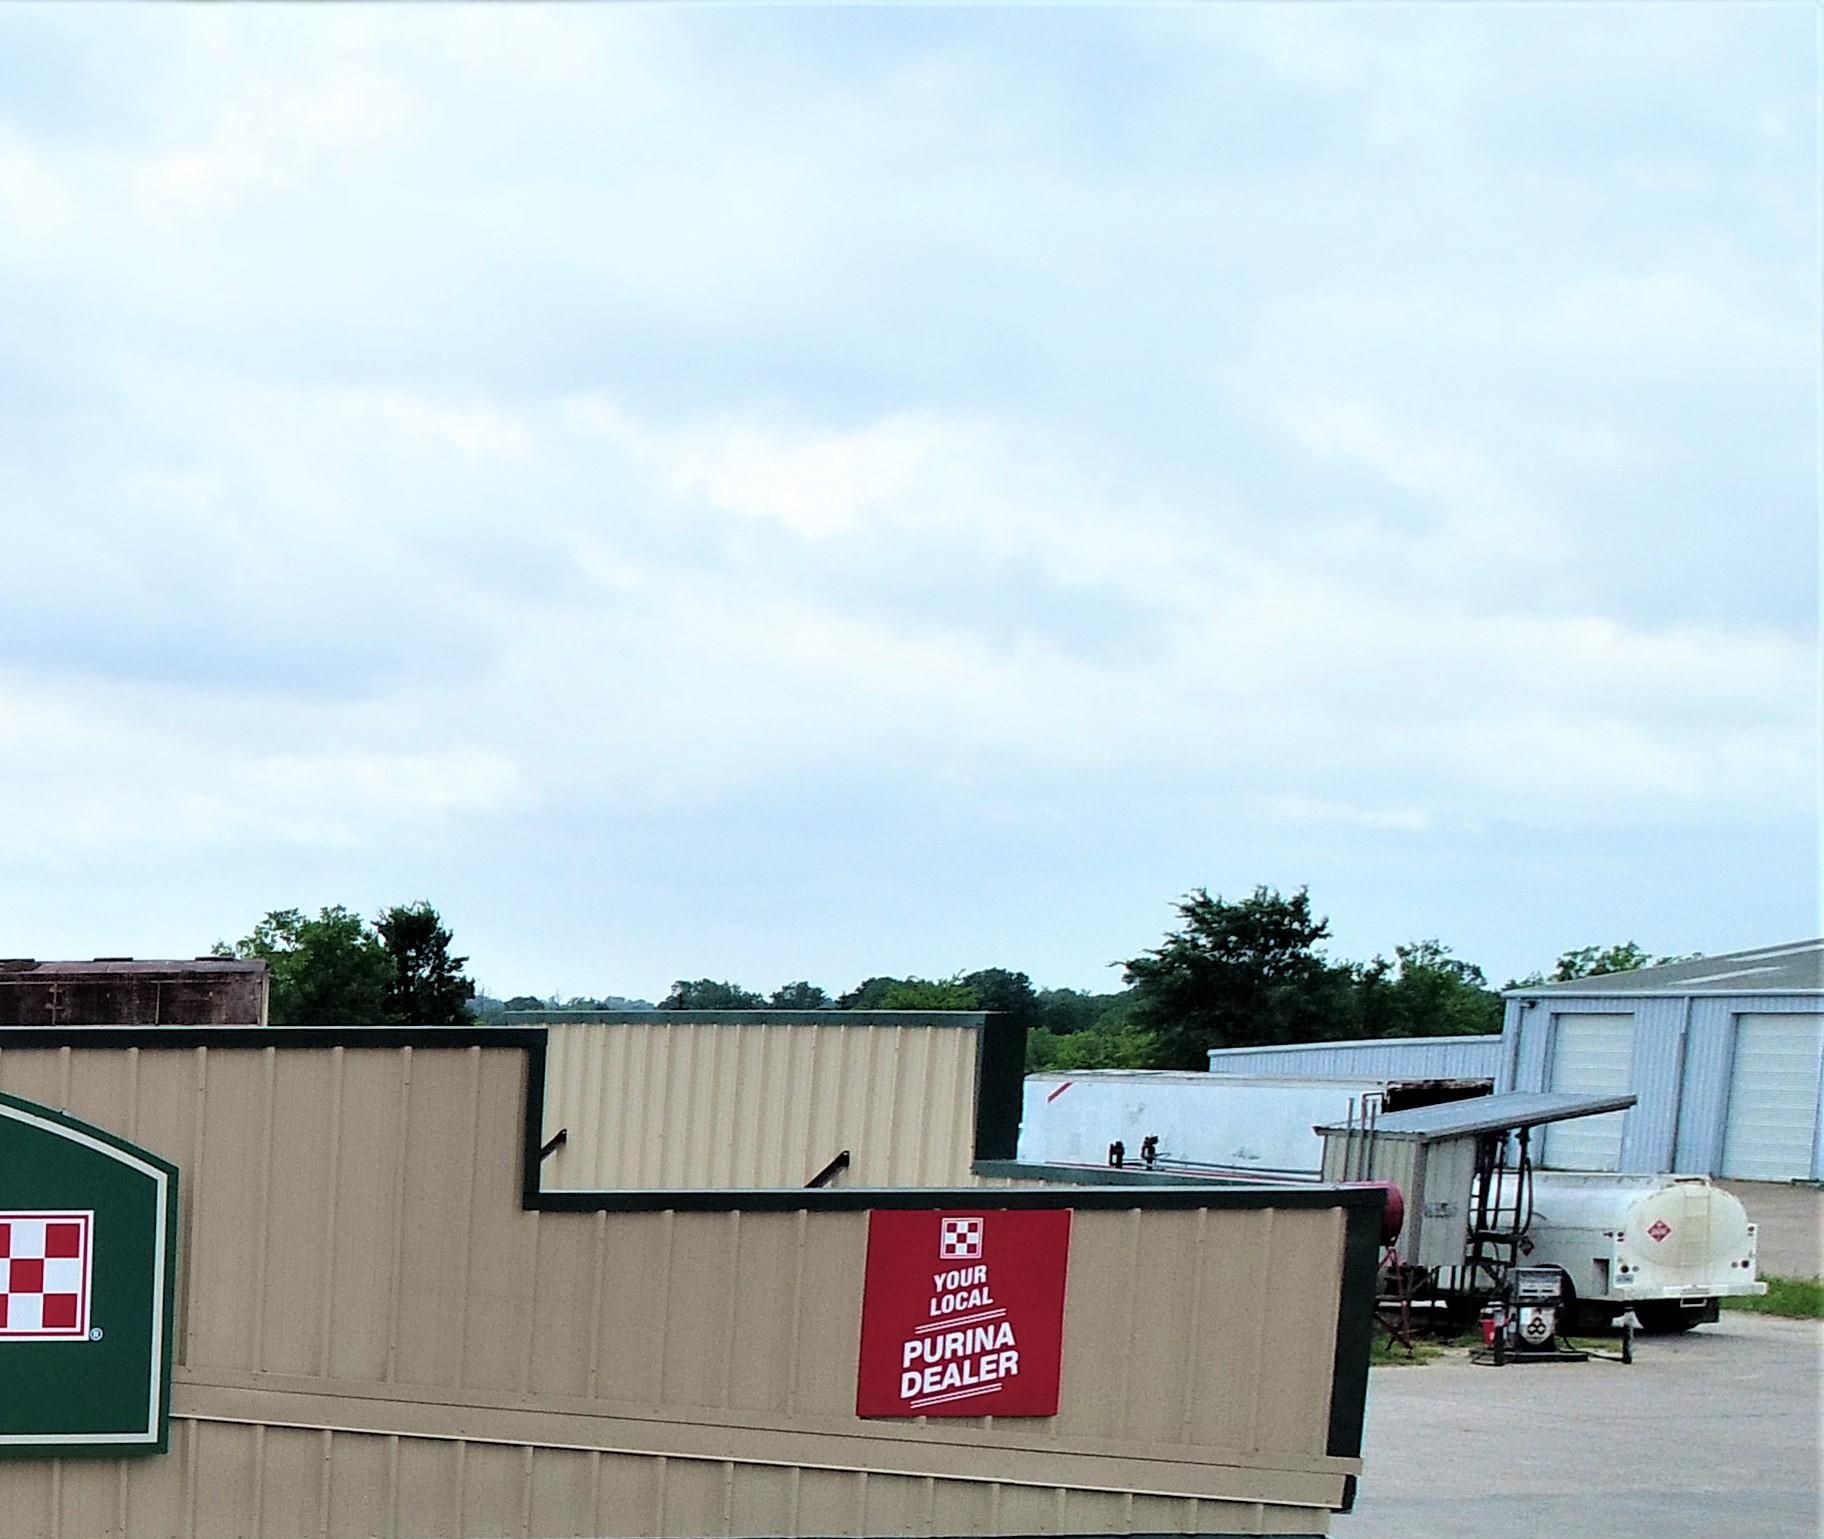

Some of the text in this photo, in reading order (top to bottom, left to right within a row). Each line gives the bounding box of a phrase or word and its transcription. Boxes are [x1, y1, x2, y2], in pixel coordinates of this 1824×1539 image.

[933, 1264, 987, 1292] YOUR
[929, 1286, 993, 1317] LOCAL
[902, 1321, 1016, 1368] PURINA
[900, 1350, 1019, 1399] DEALER
